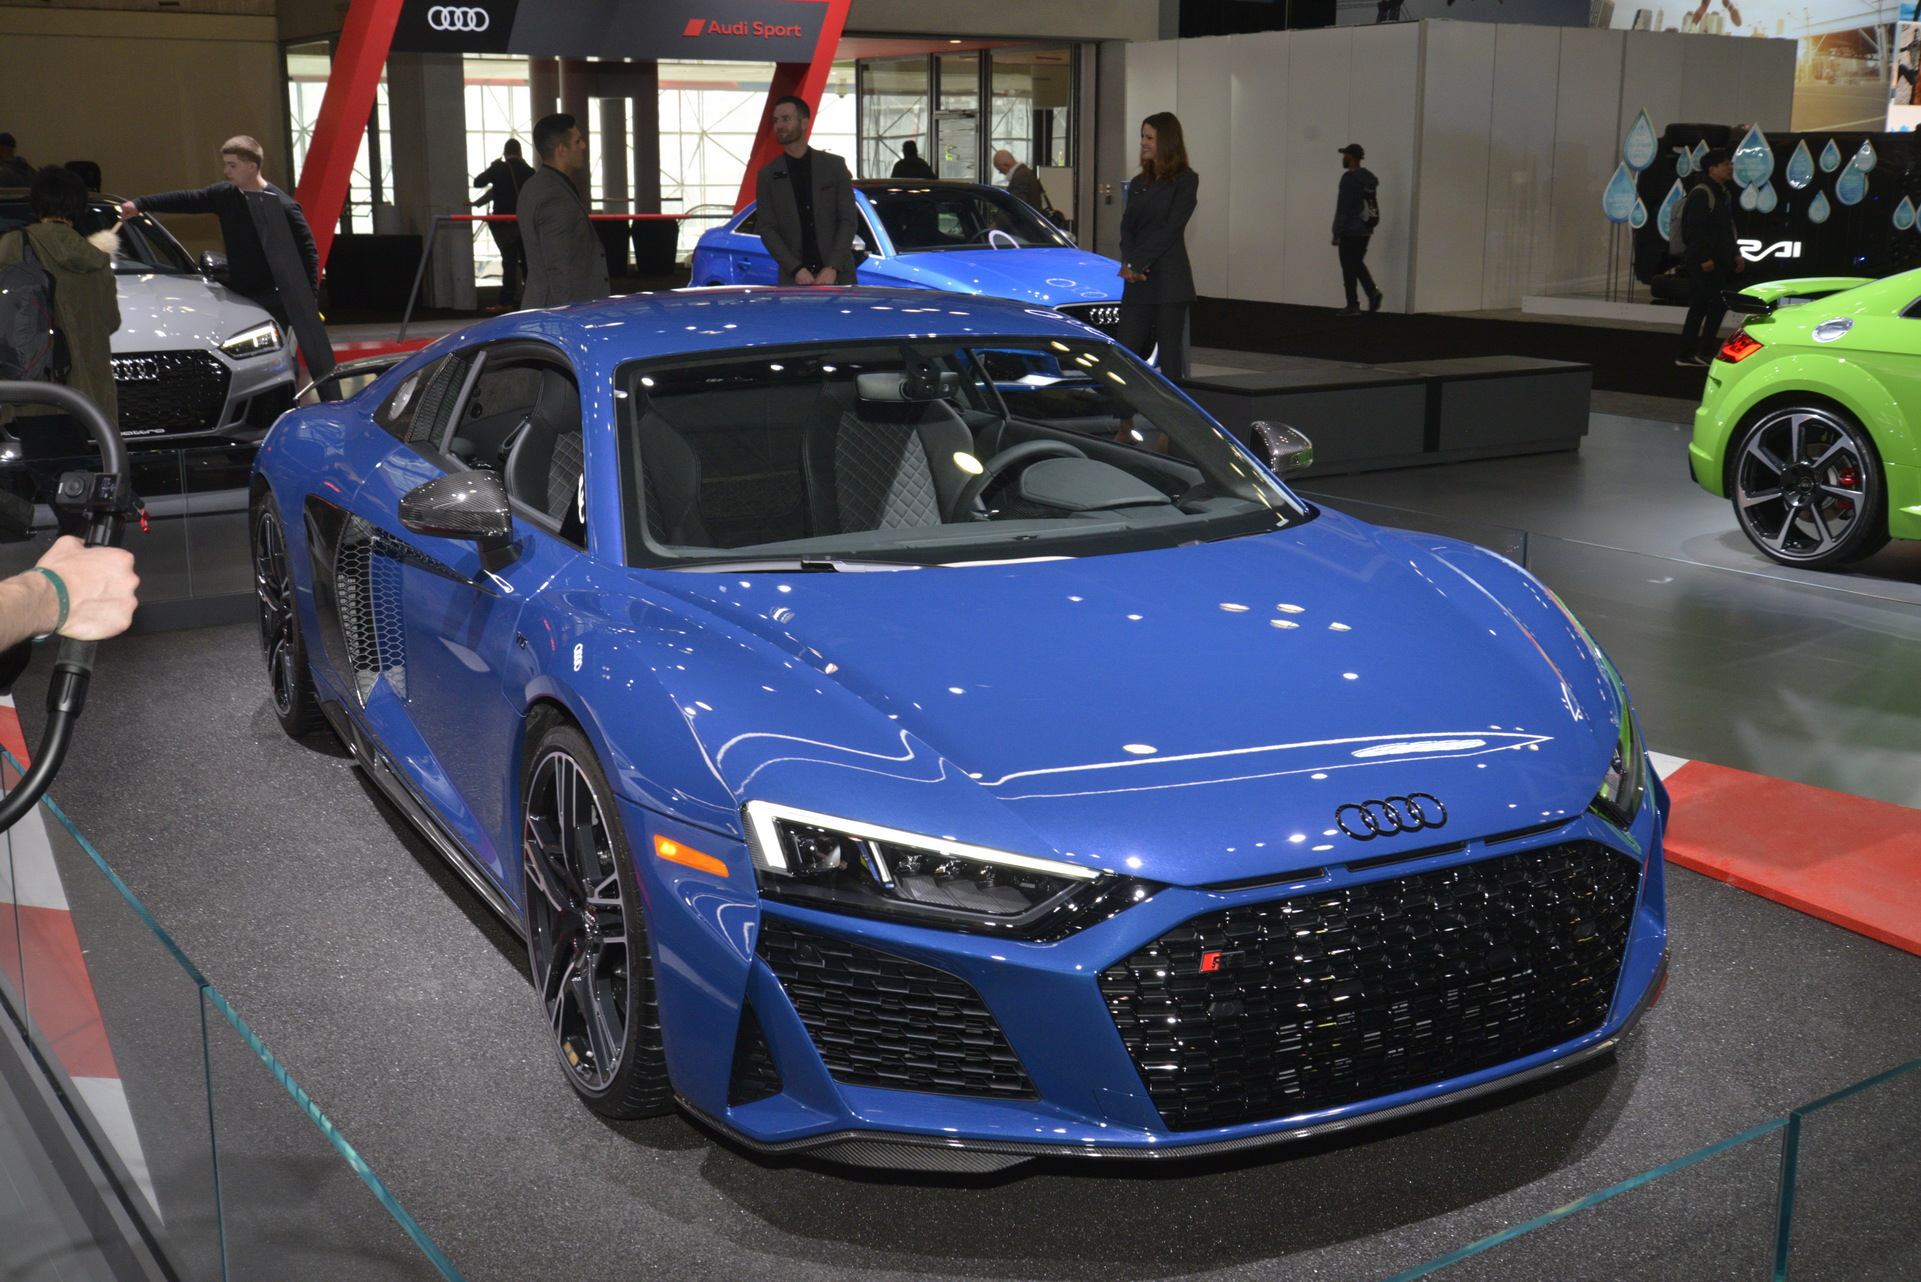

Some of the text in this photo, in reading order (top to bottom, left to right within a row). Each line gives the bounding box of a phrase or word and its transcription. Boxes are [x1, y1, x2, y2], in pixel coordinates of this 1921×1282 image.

[708, 20, 801, 39] Audi Sport
[1736, 239, 1802, 262] RAI
[120, 428, 166, 436] attro
